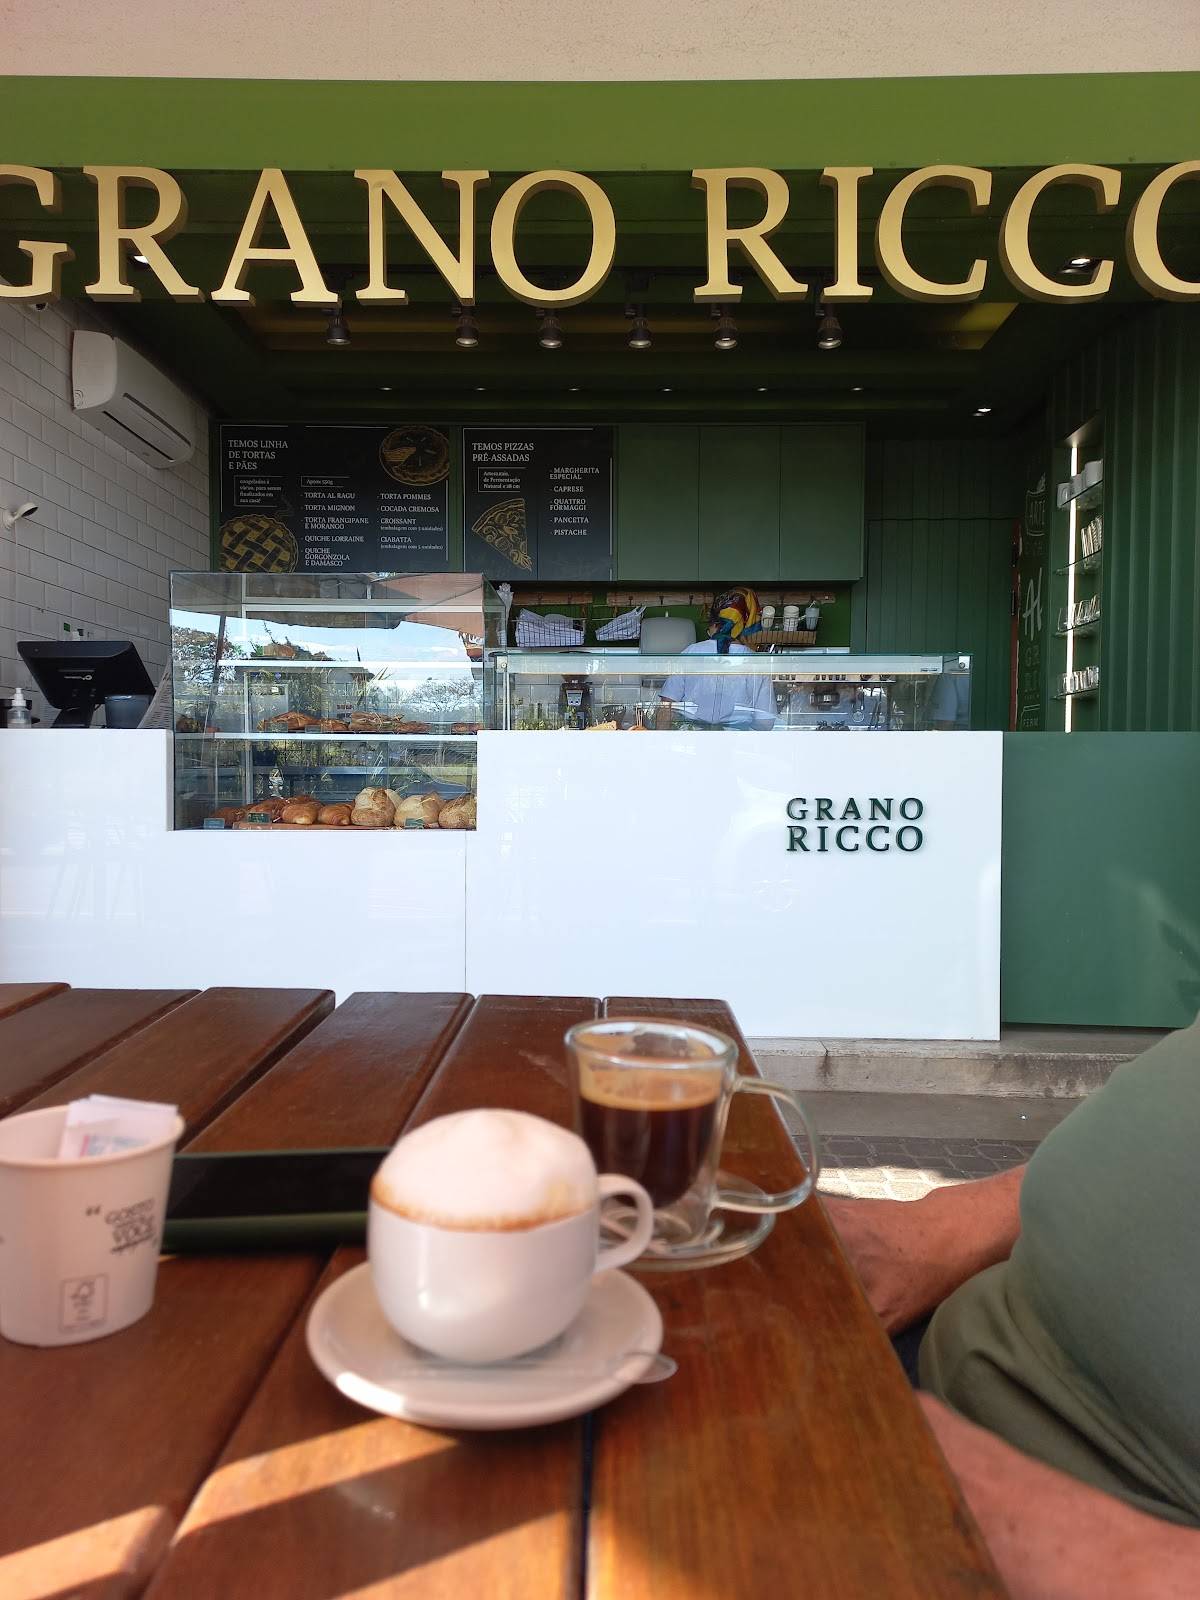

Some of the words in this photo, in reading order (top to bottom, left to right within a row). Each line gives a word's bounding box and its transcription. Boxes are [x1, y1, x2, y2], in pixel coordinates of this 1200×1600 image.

[228, 439, 258, 448] TEMOS
[260, 440, 288, 449] LINHA
[472, 443, 502, 451] TEMOS
[504, 443, 535, 451] PIZZAS
[228, 450, 240, 459] DE
[242, 451, 276, 460] TORTAS
[472, 452, 530, 462] PRÉ-ASSADAS
[228, 462, 234, 470] E
[236, 460, 258, 470] PÃES
[786, 797, 924, 820] GRANO
[786, 825, 924, 852] RICCO
